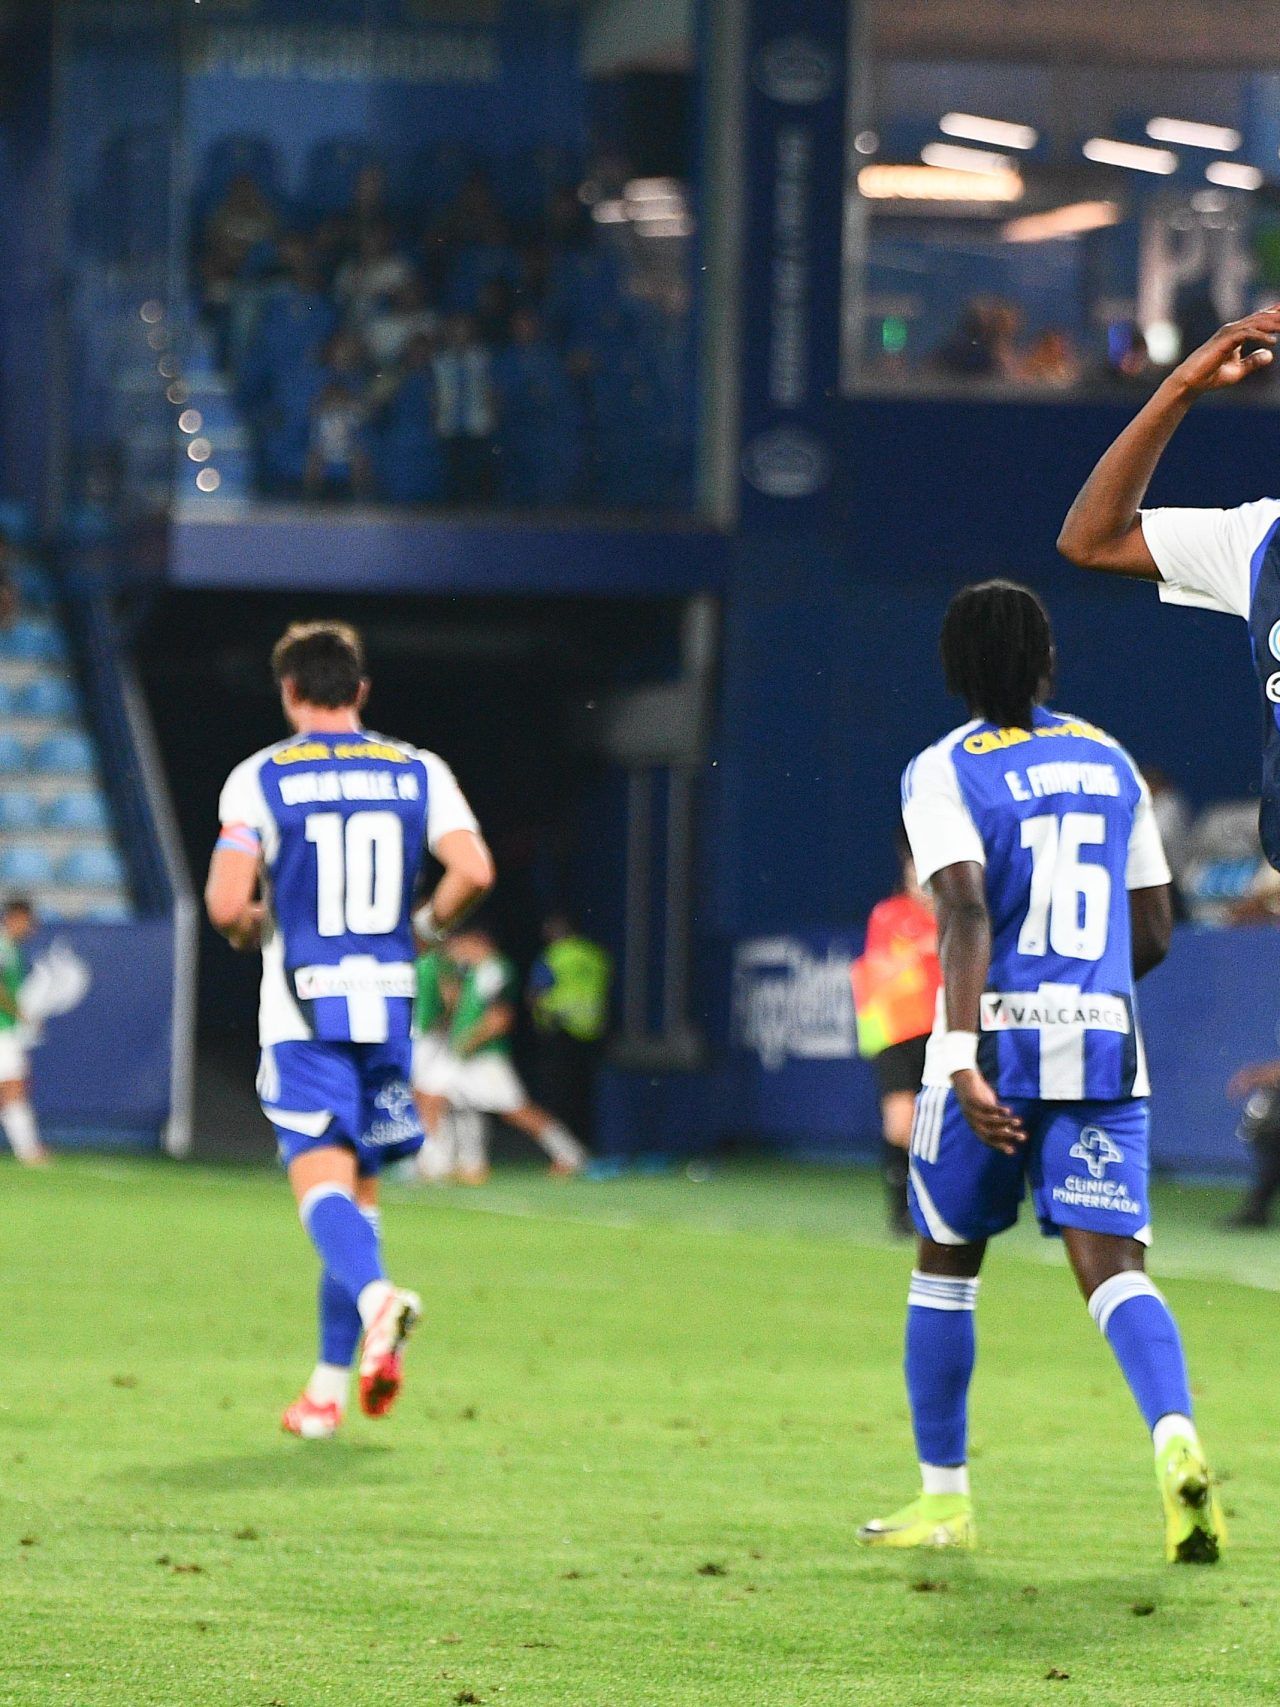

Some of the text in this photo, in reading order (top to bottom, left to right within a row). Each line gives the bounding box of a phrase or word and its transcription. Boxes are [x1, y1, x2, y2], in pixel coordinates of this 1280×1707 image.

[305, 810, 404, 936] 10
[1017, 812, 1111, 961] 16
[1010, 1007, 1124, 1028] VALCARCE
